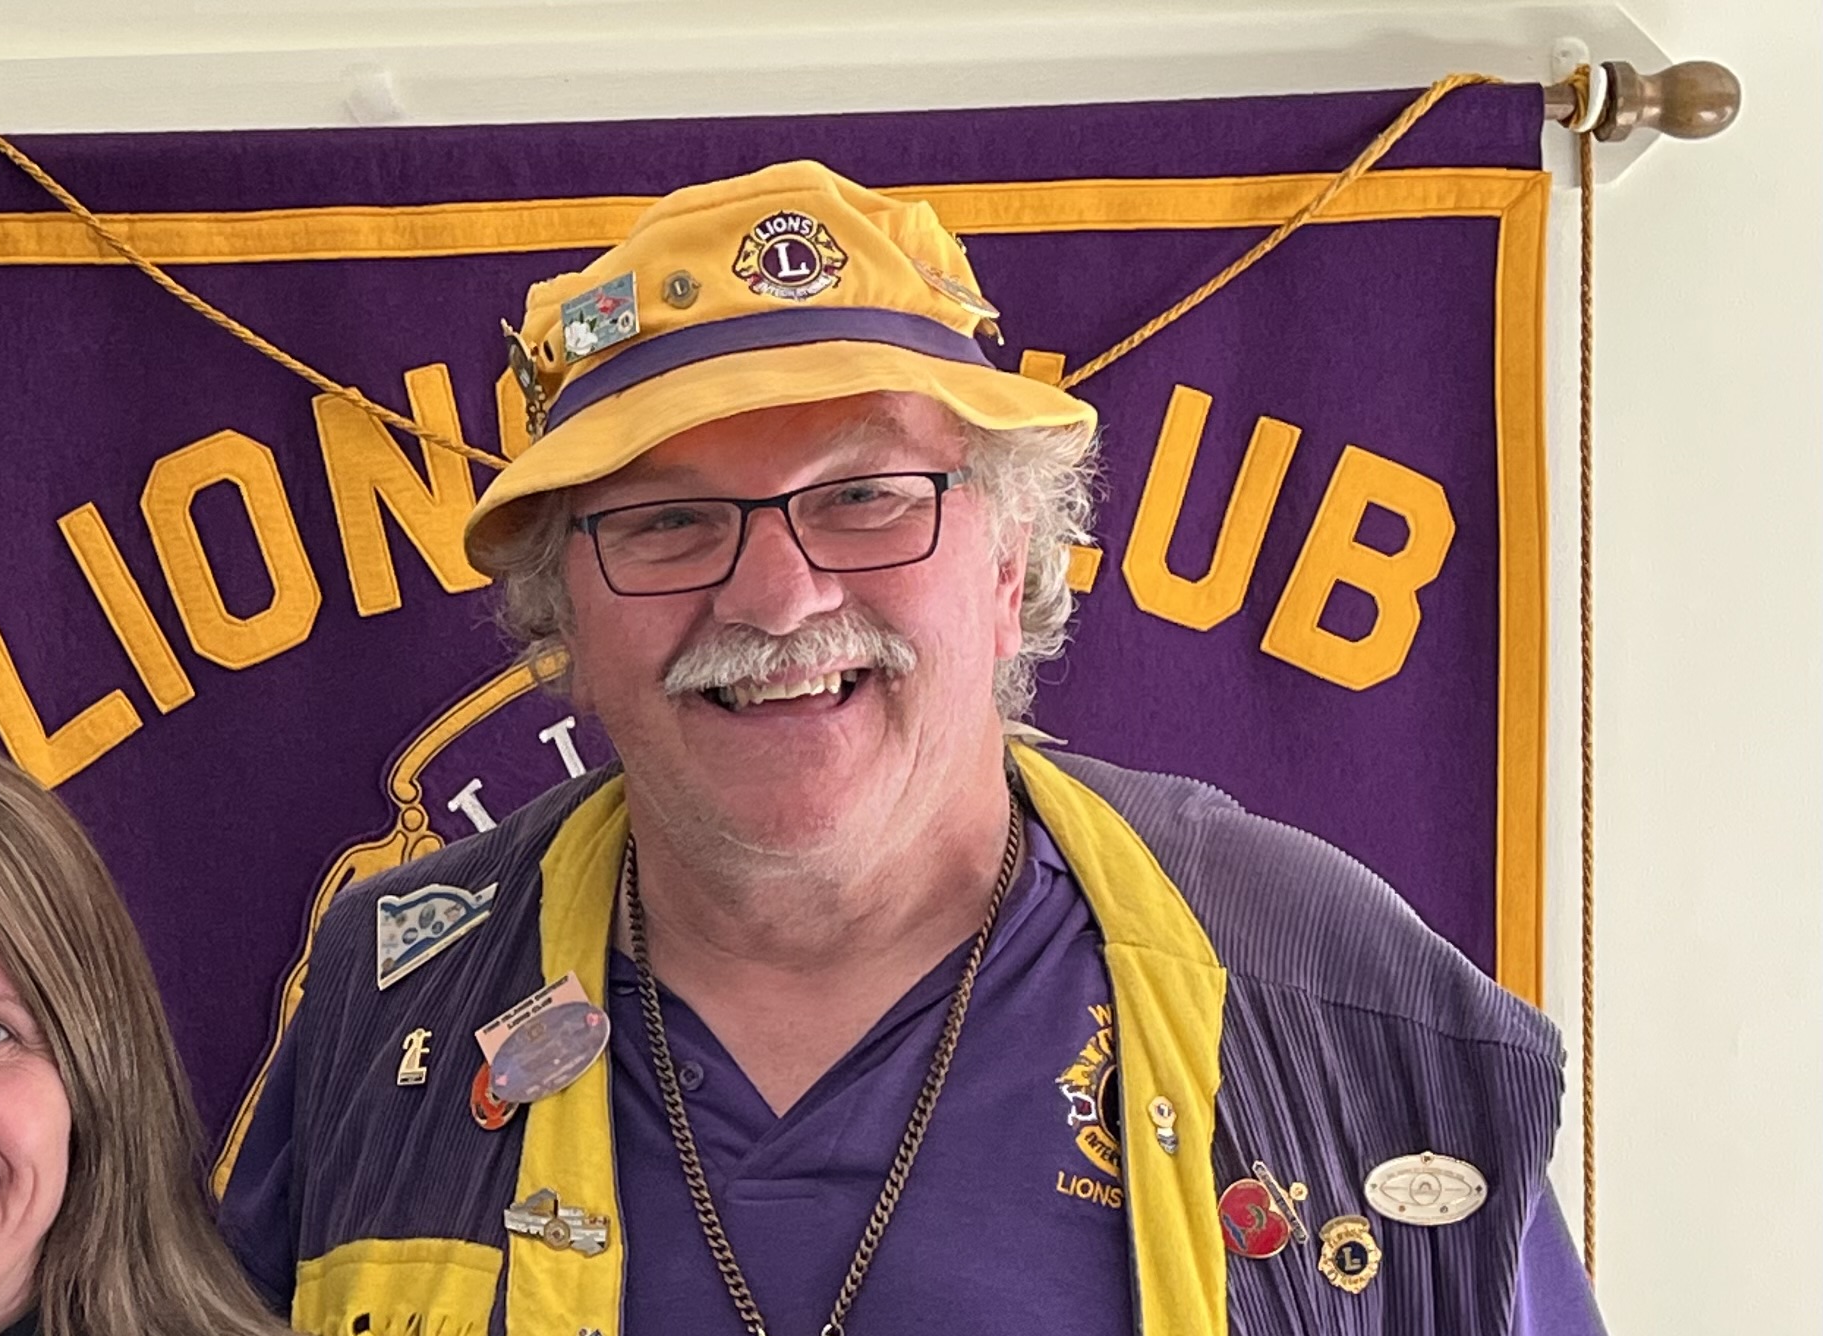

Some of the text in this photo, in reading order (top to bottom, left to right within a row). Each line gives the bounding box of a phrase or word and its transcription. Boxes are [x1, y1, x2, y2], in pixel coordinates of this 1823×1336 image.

[755, 215, 813, 240] LIONS
[774, 242, 811, 278] L
[1055, 1170, 1125, 1209] LIONS
